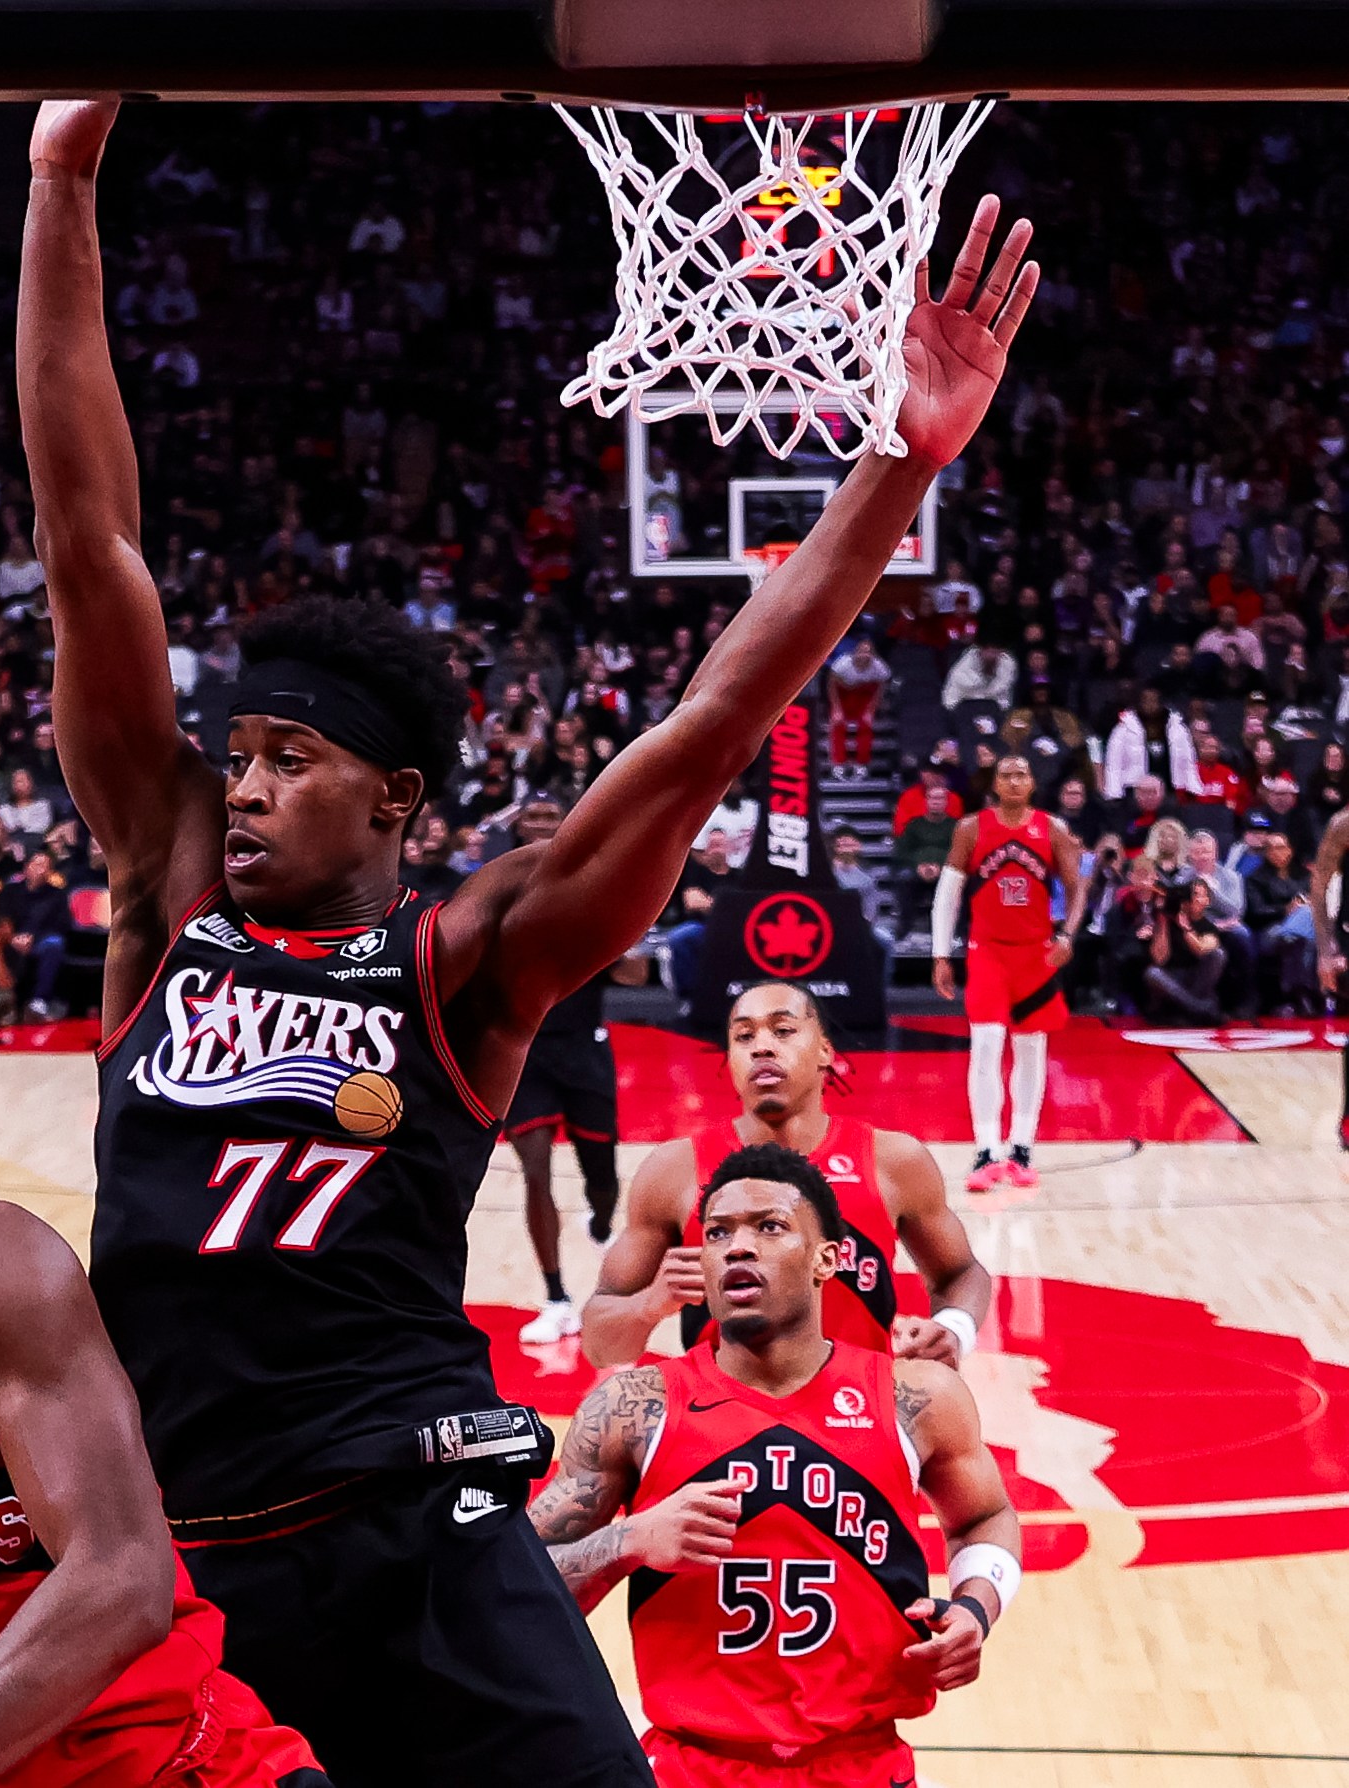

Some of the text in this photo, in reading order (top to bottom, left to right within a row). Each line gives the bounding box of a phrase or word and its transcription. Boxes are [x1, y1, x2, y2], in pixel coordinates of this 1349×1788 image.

[996, 876, 1028, 907] 12
[199, 912, 248, 946] NIKE
[326, 966, 402, 981] ypto.com
[199, 1138, 387, 1255] 77
[825, 1416, 849, 1428] Sun
[460, 1487, 494, 1509] NIKE
[728, 1446, 889, 1566] PTORS
[718, 1558, 837, 1657] 55
